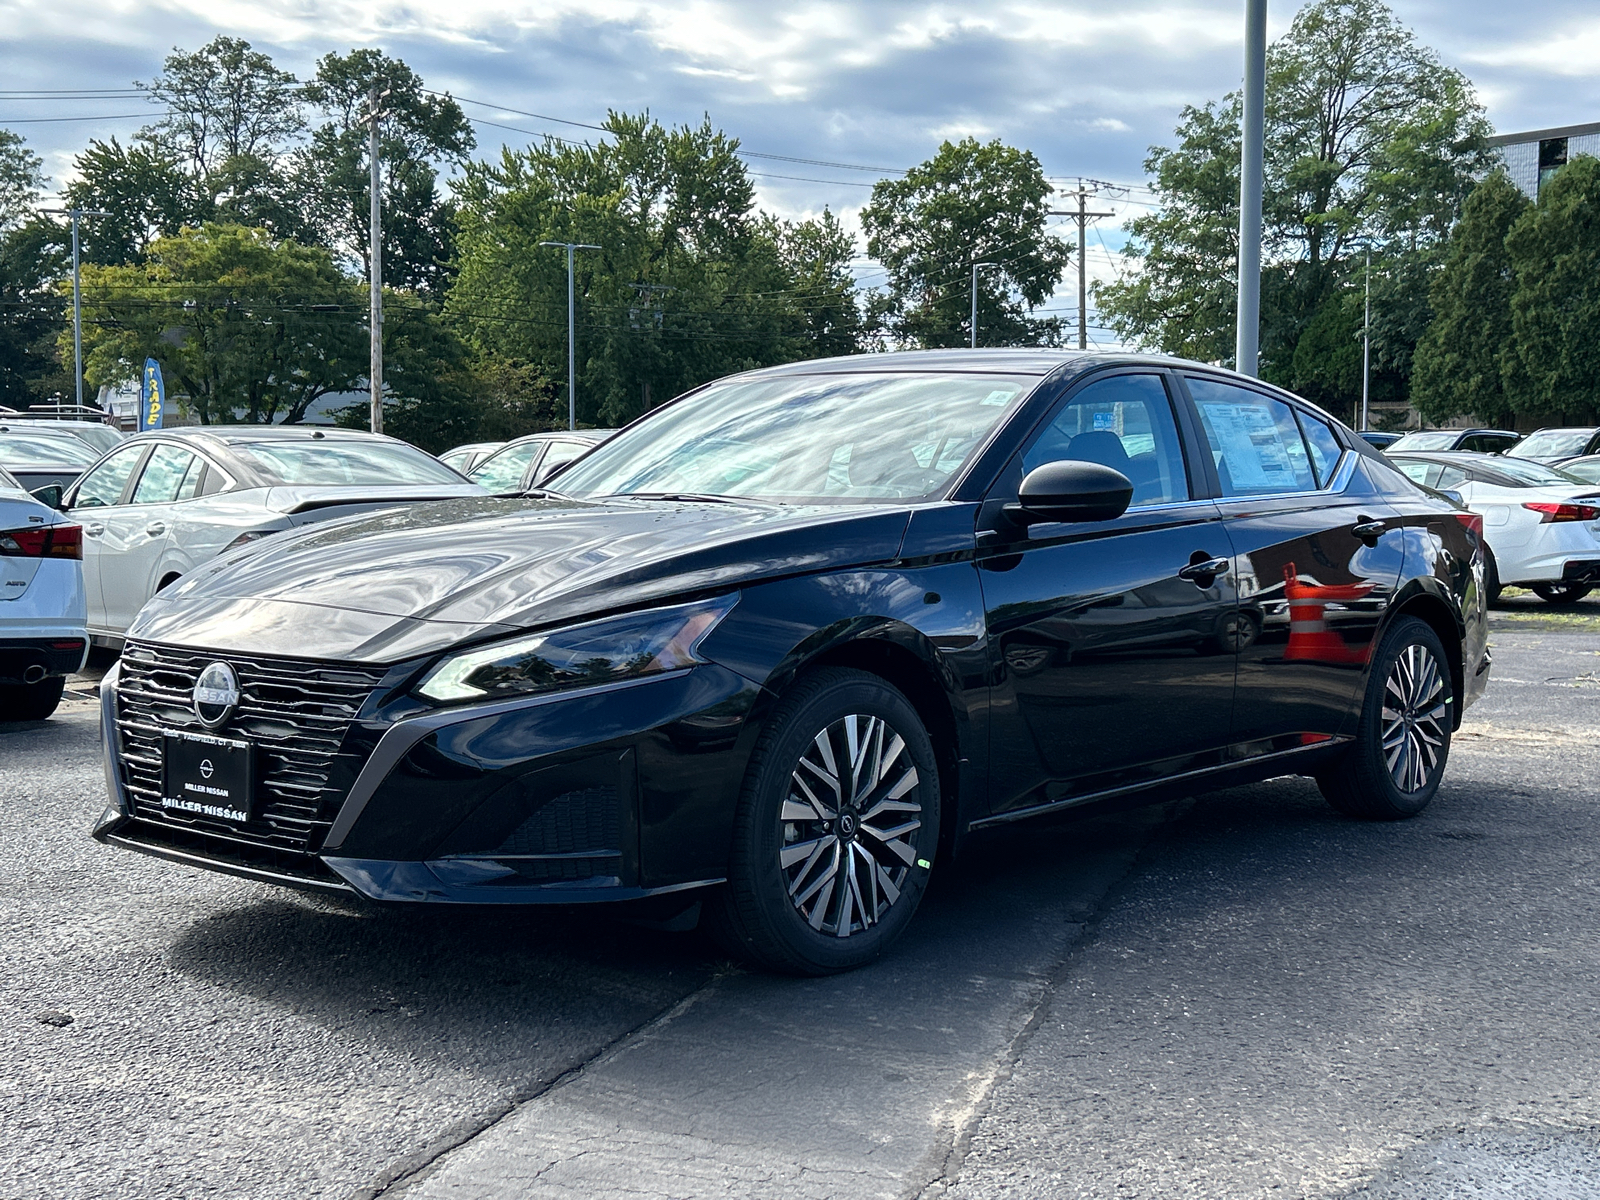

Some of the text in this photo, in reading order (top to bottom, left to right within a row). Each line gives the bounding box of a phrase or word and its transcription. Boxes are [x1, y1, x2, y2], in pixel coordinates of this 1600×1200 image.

[147, 367, 161, 425] TRADE
[196, 687, 238, 704] SSAN
[184, 782, 229, 797] MILLER NISSAN
[162, 797, 247, 822] MILLER NISSAN
